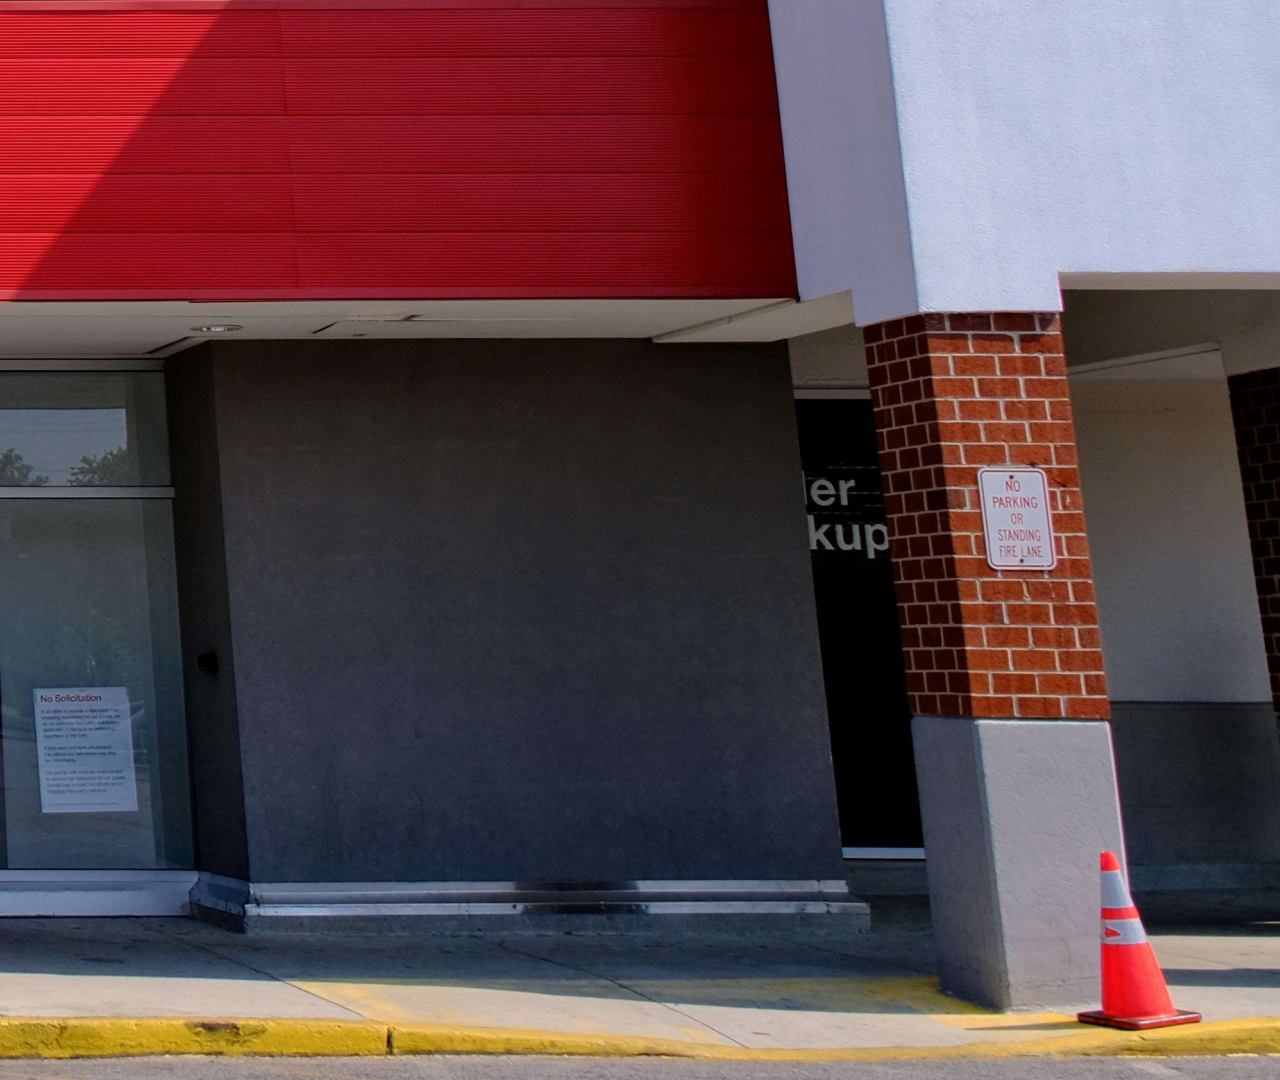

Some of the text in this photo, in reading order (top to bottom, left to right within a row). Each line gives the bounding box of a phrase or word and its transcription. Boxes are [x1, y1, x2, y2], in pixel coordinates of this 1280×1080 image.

[801, 470, 856, 507] er
[1005, 480, 1021, 492] NO
[992, 496, 1038, 508] PARKING
[1010, 512, 1024, 525] OR
[998, 529, 1041, 541] STANDING
[999, 545, 1043, 558] FIRE LANE
[41, 693, 102, 703] No Solicitation
